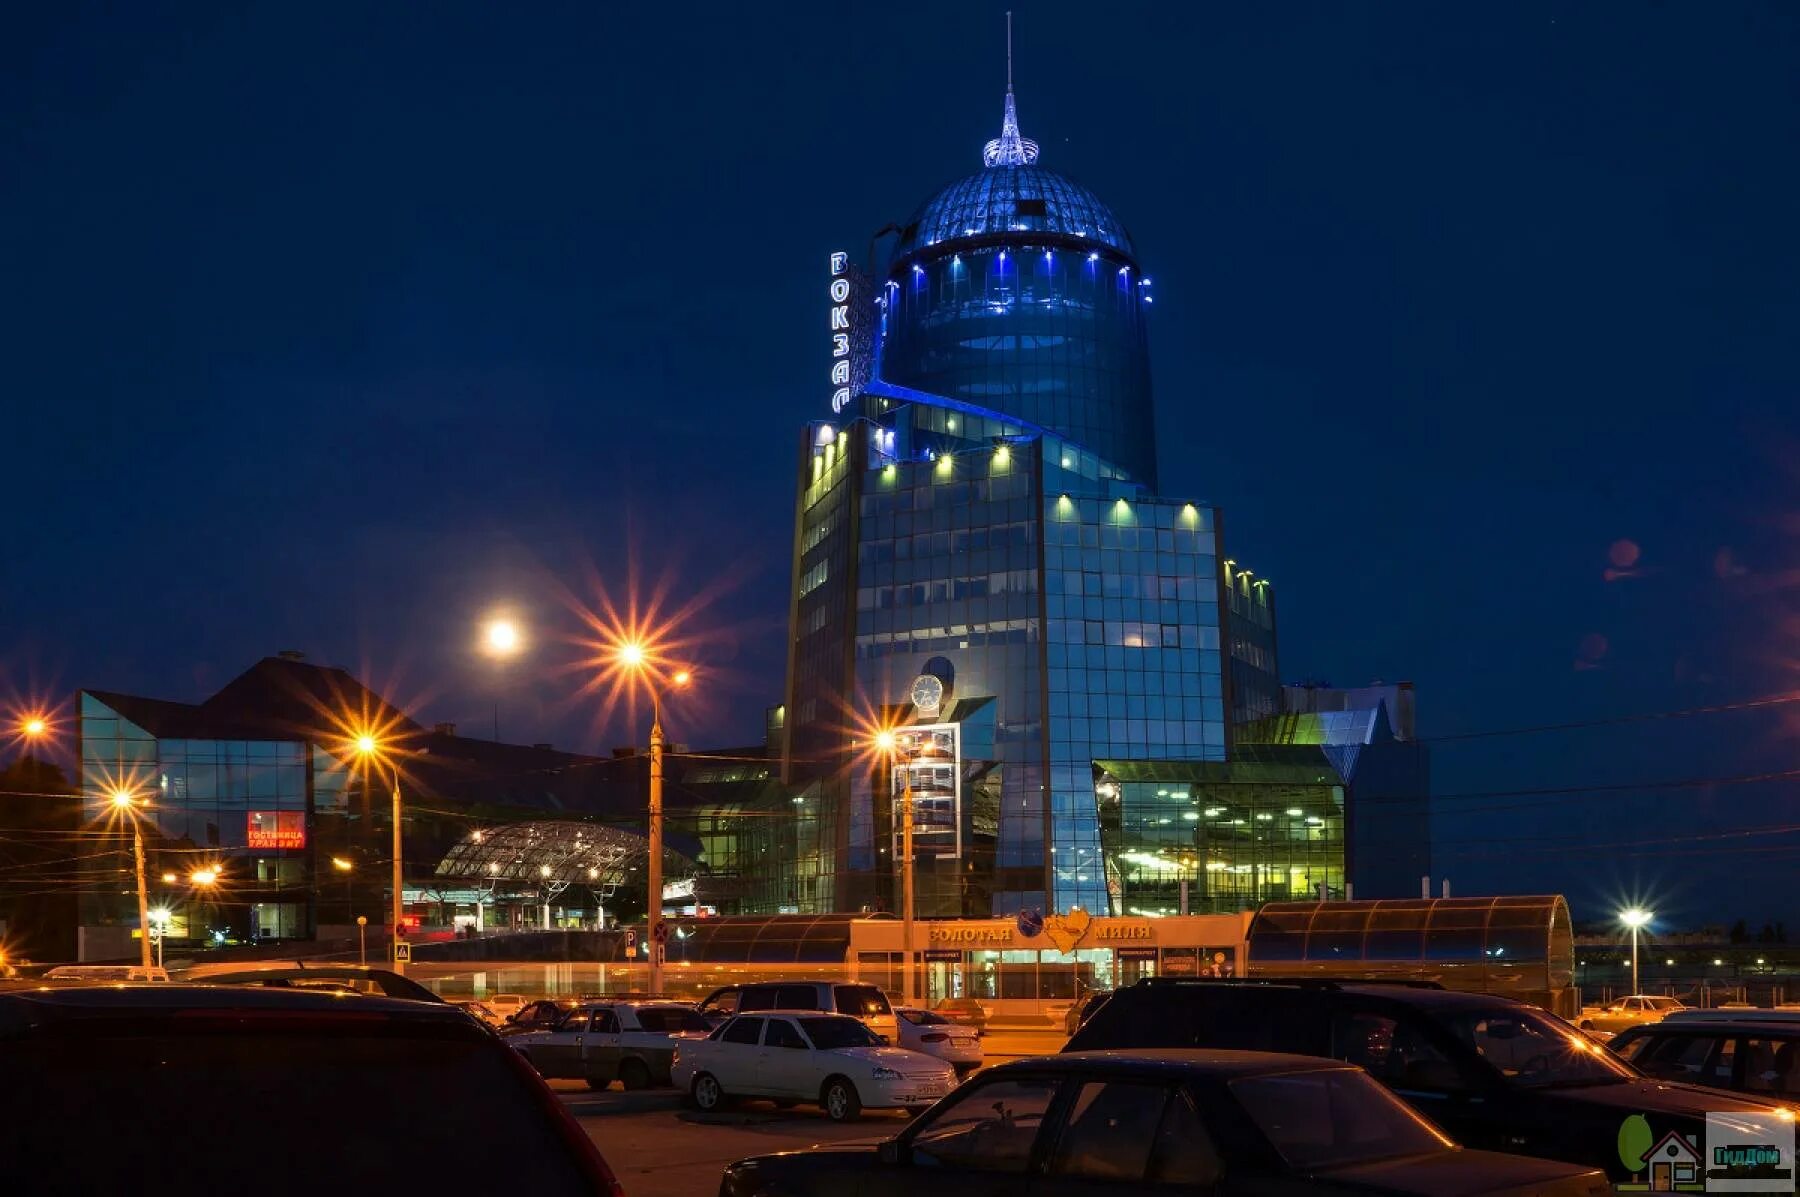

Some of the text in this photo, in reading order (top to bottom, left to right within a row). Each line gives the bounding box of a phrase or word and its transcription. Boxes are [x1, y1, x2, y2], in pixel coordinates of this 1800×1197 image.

[831, 251, 849, 413] ВОКЗАЛ
[929, 926, 1152, 941] ЗОЛОТАЯ МИЛЯ
